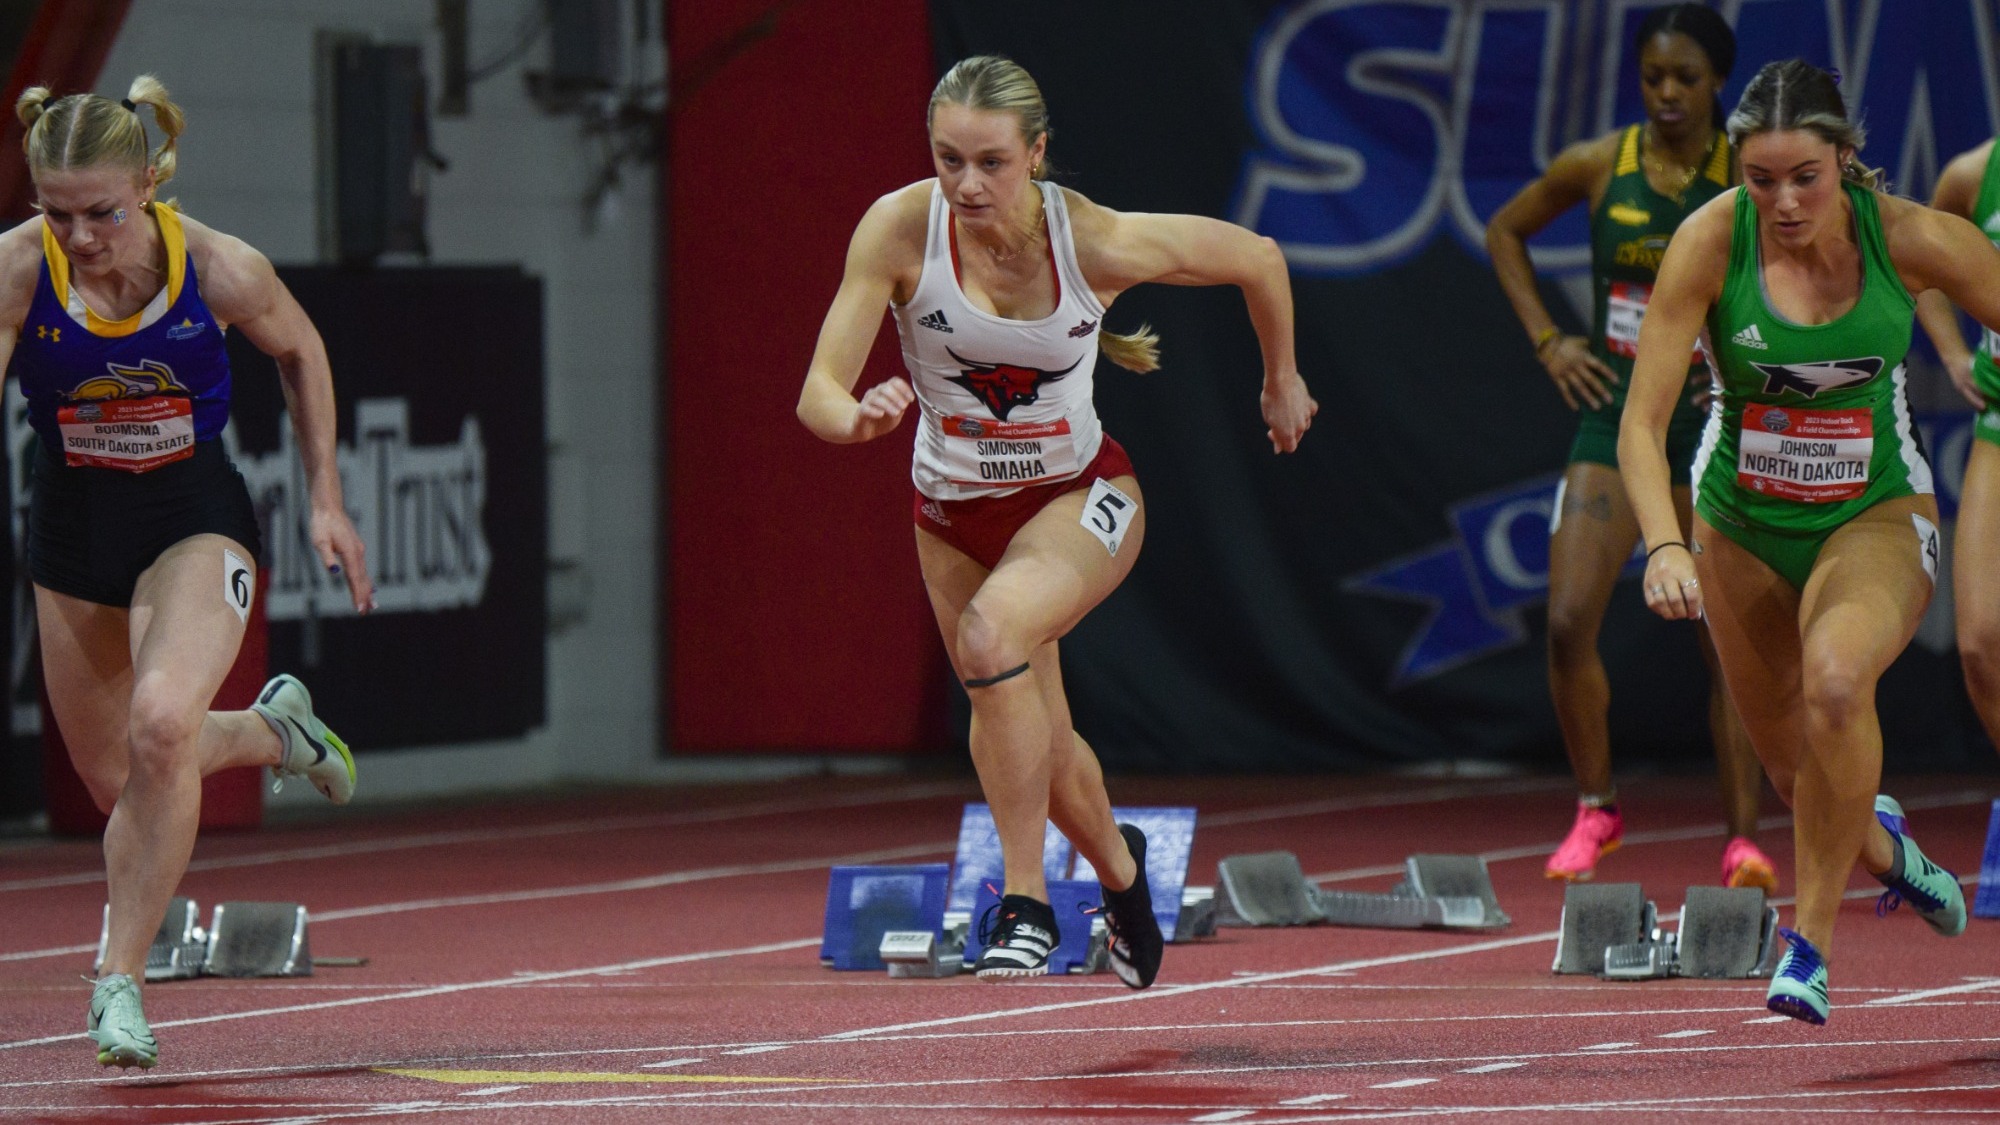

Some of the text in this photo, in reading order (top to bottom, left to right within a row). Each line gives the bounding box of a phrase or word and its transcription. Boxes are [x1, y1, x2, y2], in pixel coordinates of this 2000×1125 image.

[917, 319, 953, 334] adidas
[1732, 336, 1768, 350] adidas
[154, 400, 169, 408] Track
[1805, 416, 1854, 425] 2023 Indoor Track
[94, 424, 161, 436] BOOMSMA
[1013, 425, 1057, 437] Championships
[1803, 426, 1818, 434] Field
[1818, 427, 1861, 436] Championships
[68, 434, 190, 455] SOUTH DAKOTA STATE
[977, 441, 1042, 456] SIMONSON
[1778, 440, 1837, 457] JOHNSON
[980, 460, 1046, 480] OMAHA
[1745, 453, 1864, 482] NORTH DAKOTA
[1784, 487, 1812, 497] University
[1818, 489, 1834, 497] South
[1091, 493, 1127, 534] 5
[231, 568, 250, 609] 6
